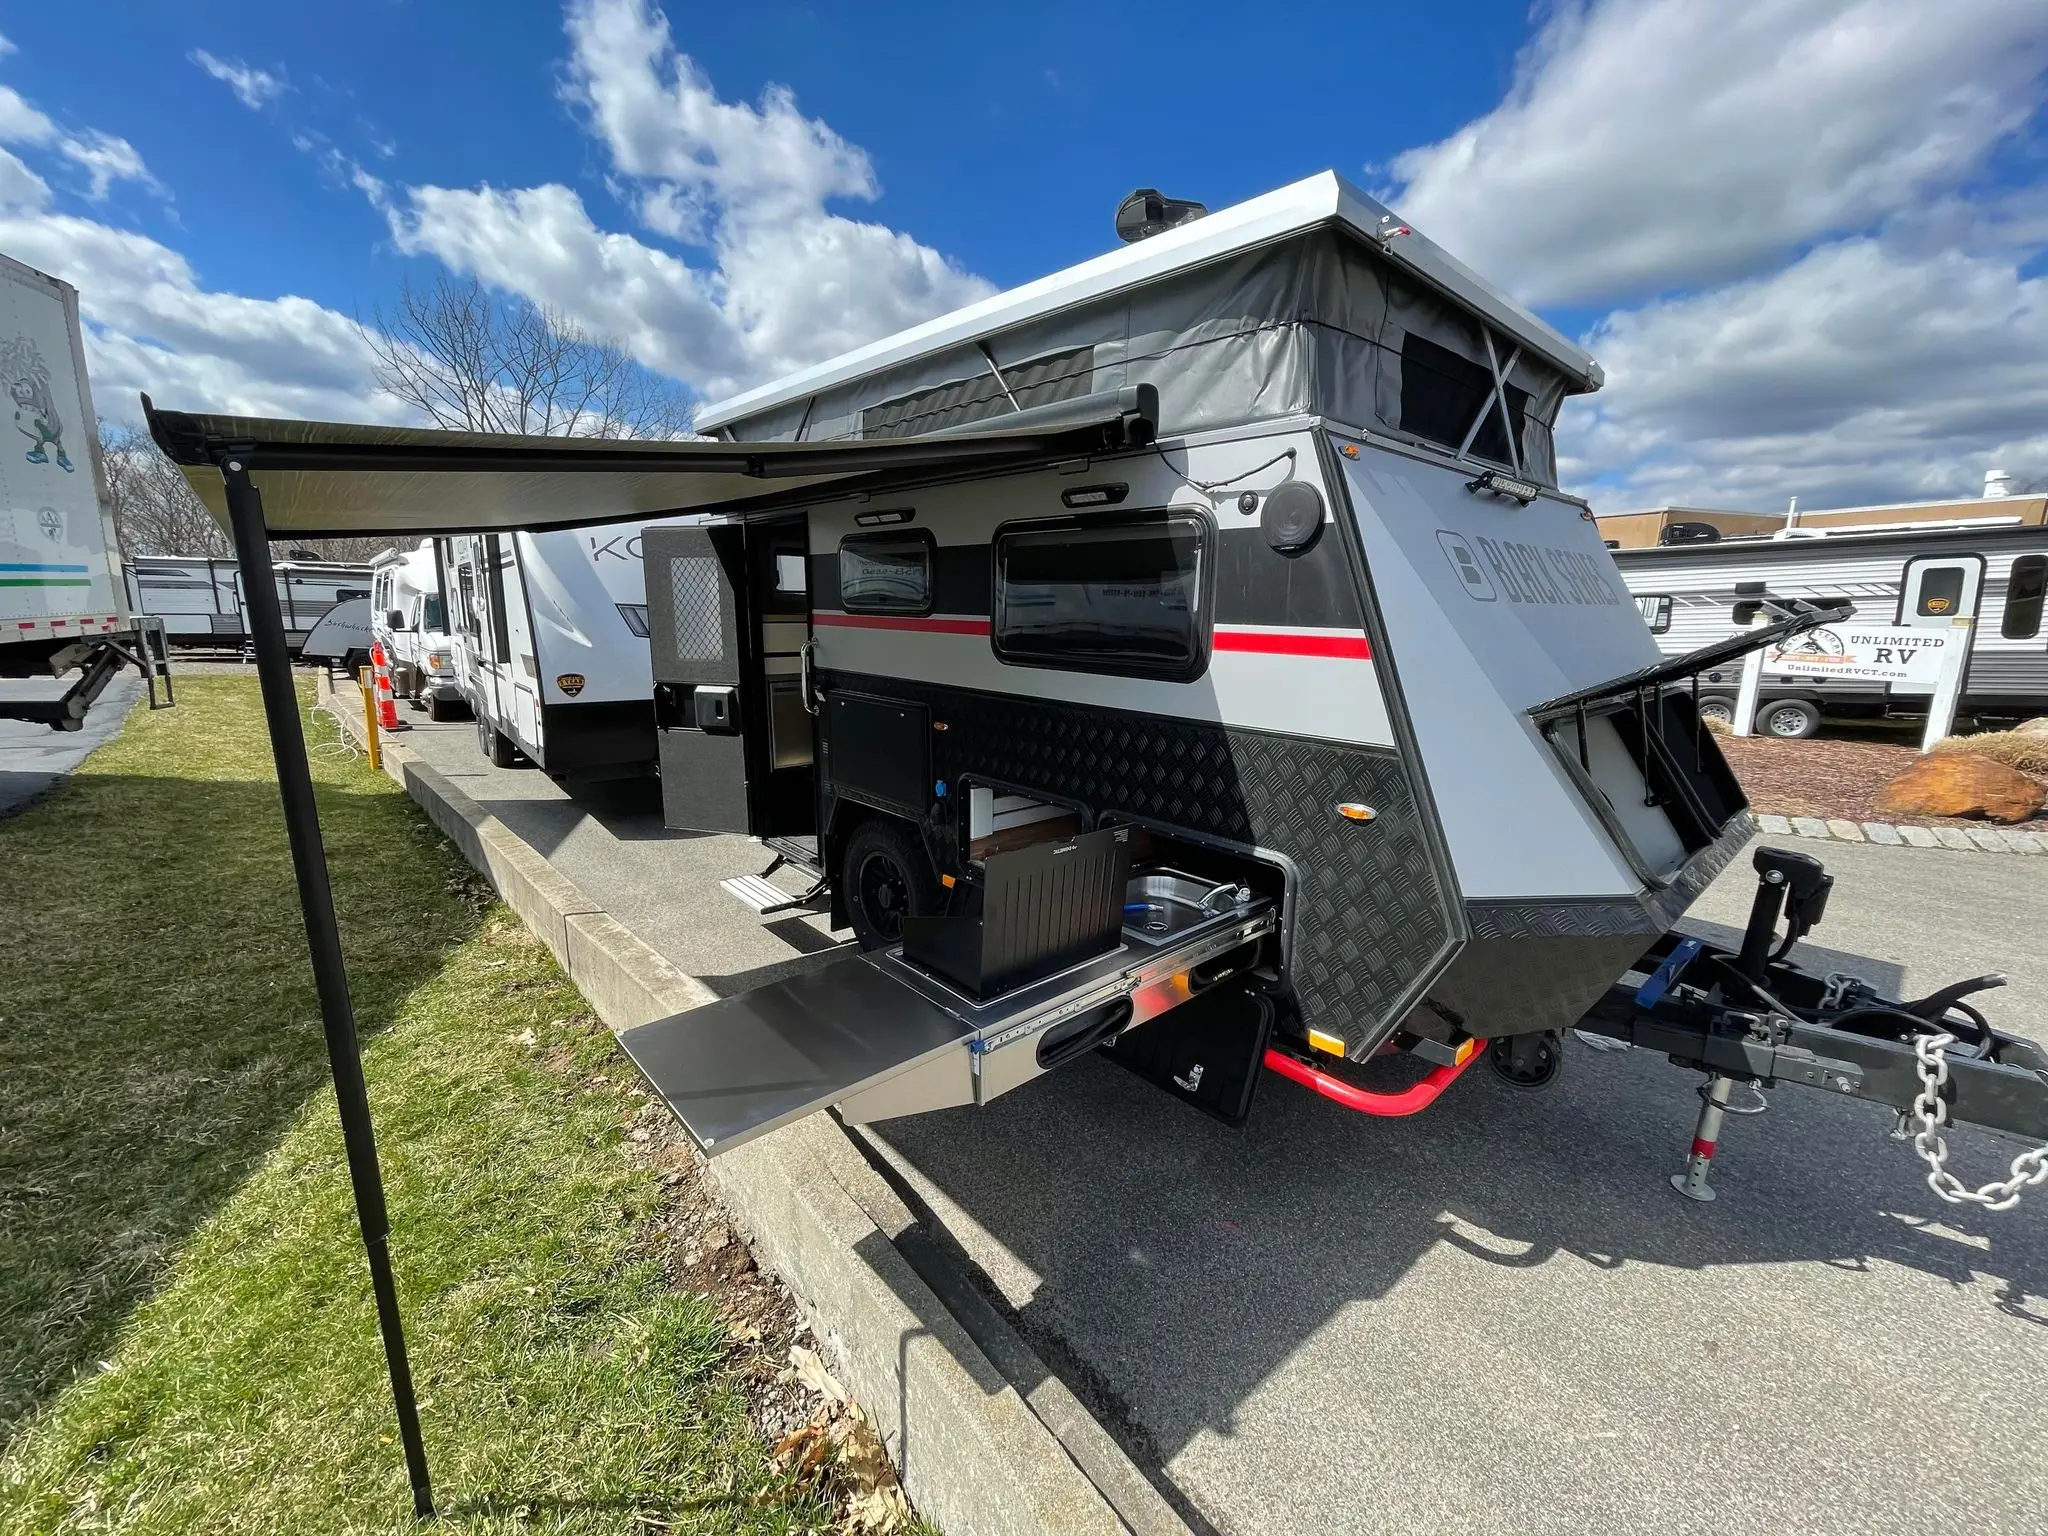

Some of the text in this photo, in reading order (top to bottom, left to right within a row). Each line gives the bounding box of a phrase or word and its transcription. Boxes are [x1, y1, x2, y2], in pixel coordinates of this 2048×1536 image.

[1476, 536, 1620, 605] BLACK SERIES
[1850, 635, 1945, 648] UNLIMITED
[1874, 648, 1918, 665] RV
[1788, 664, 1908, 678] UnlimitedRVCT.com
